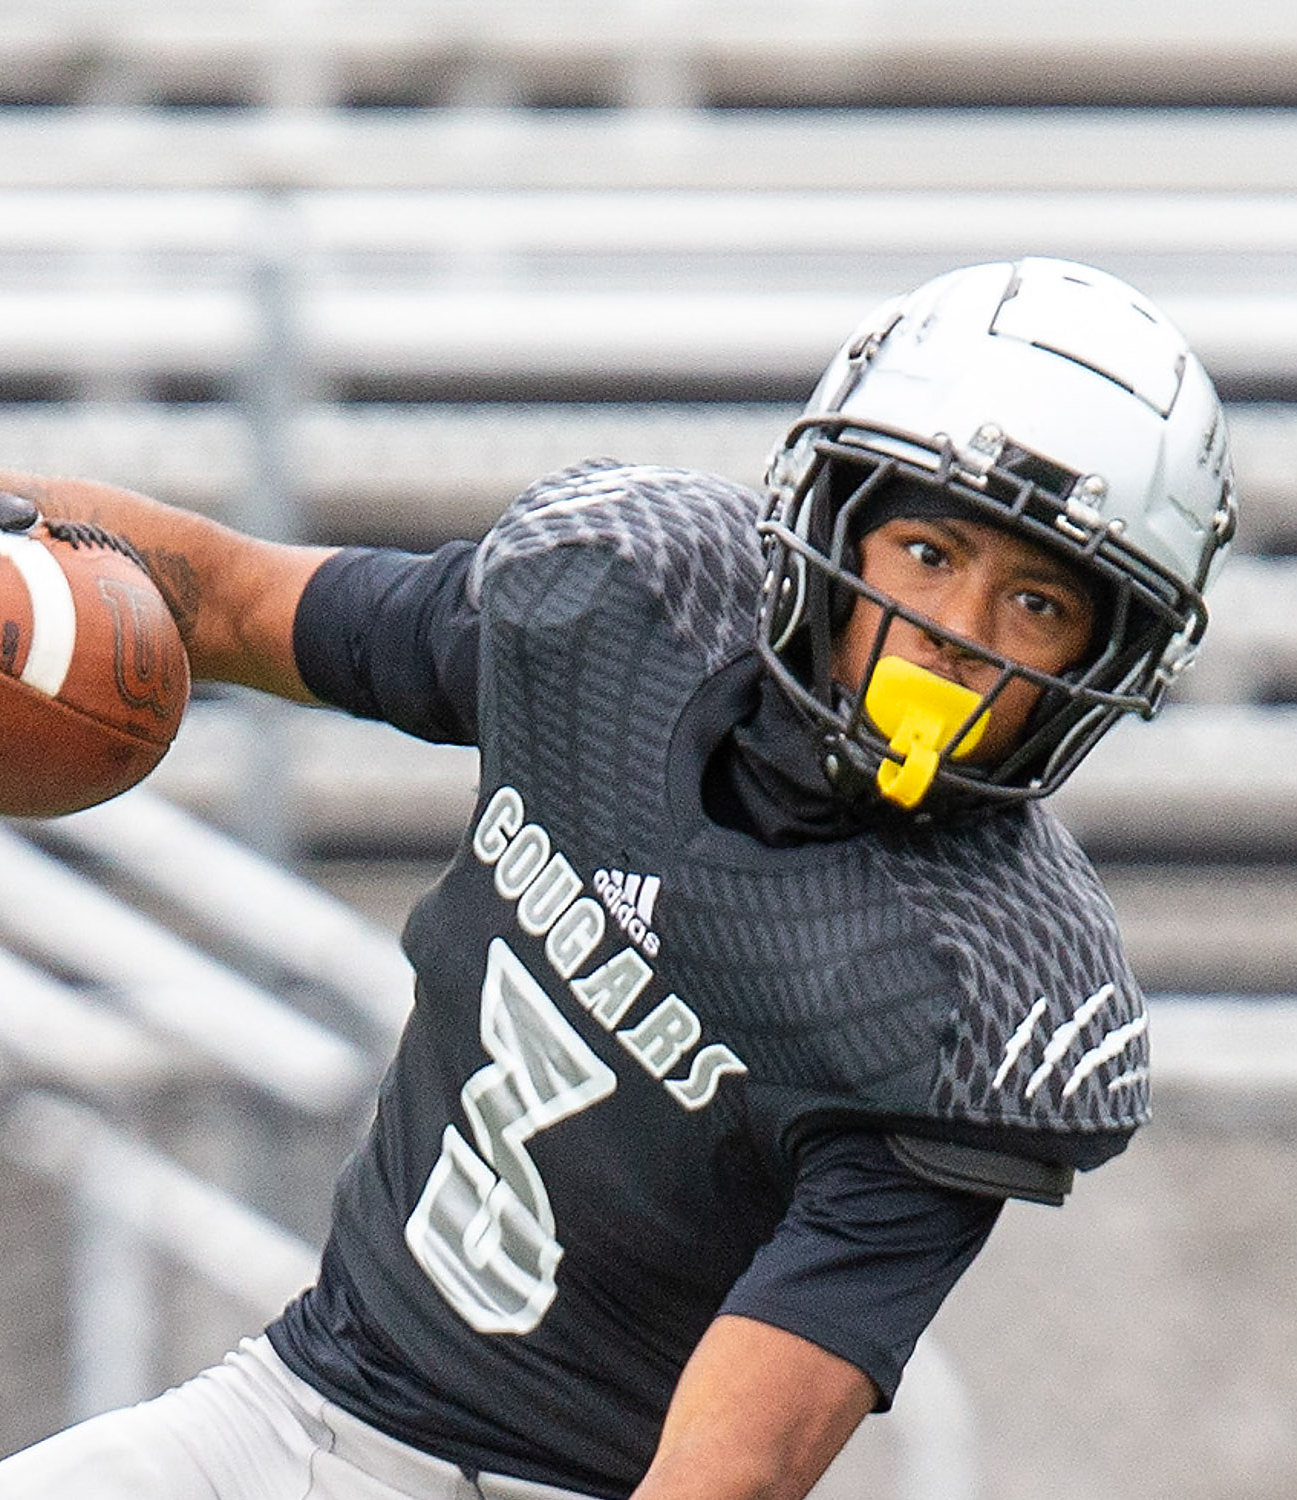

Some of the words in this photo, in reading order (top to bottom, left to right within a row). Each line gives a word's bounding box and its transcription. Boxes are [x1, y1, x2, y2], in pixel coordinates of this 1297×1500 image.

[473, 786, 748, 1111] COUGARS
[593, 868, 661, 957] adidas
[405, 936, 617, 1335] 3
